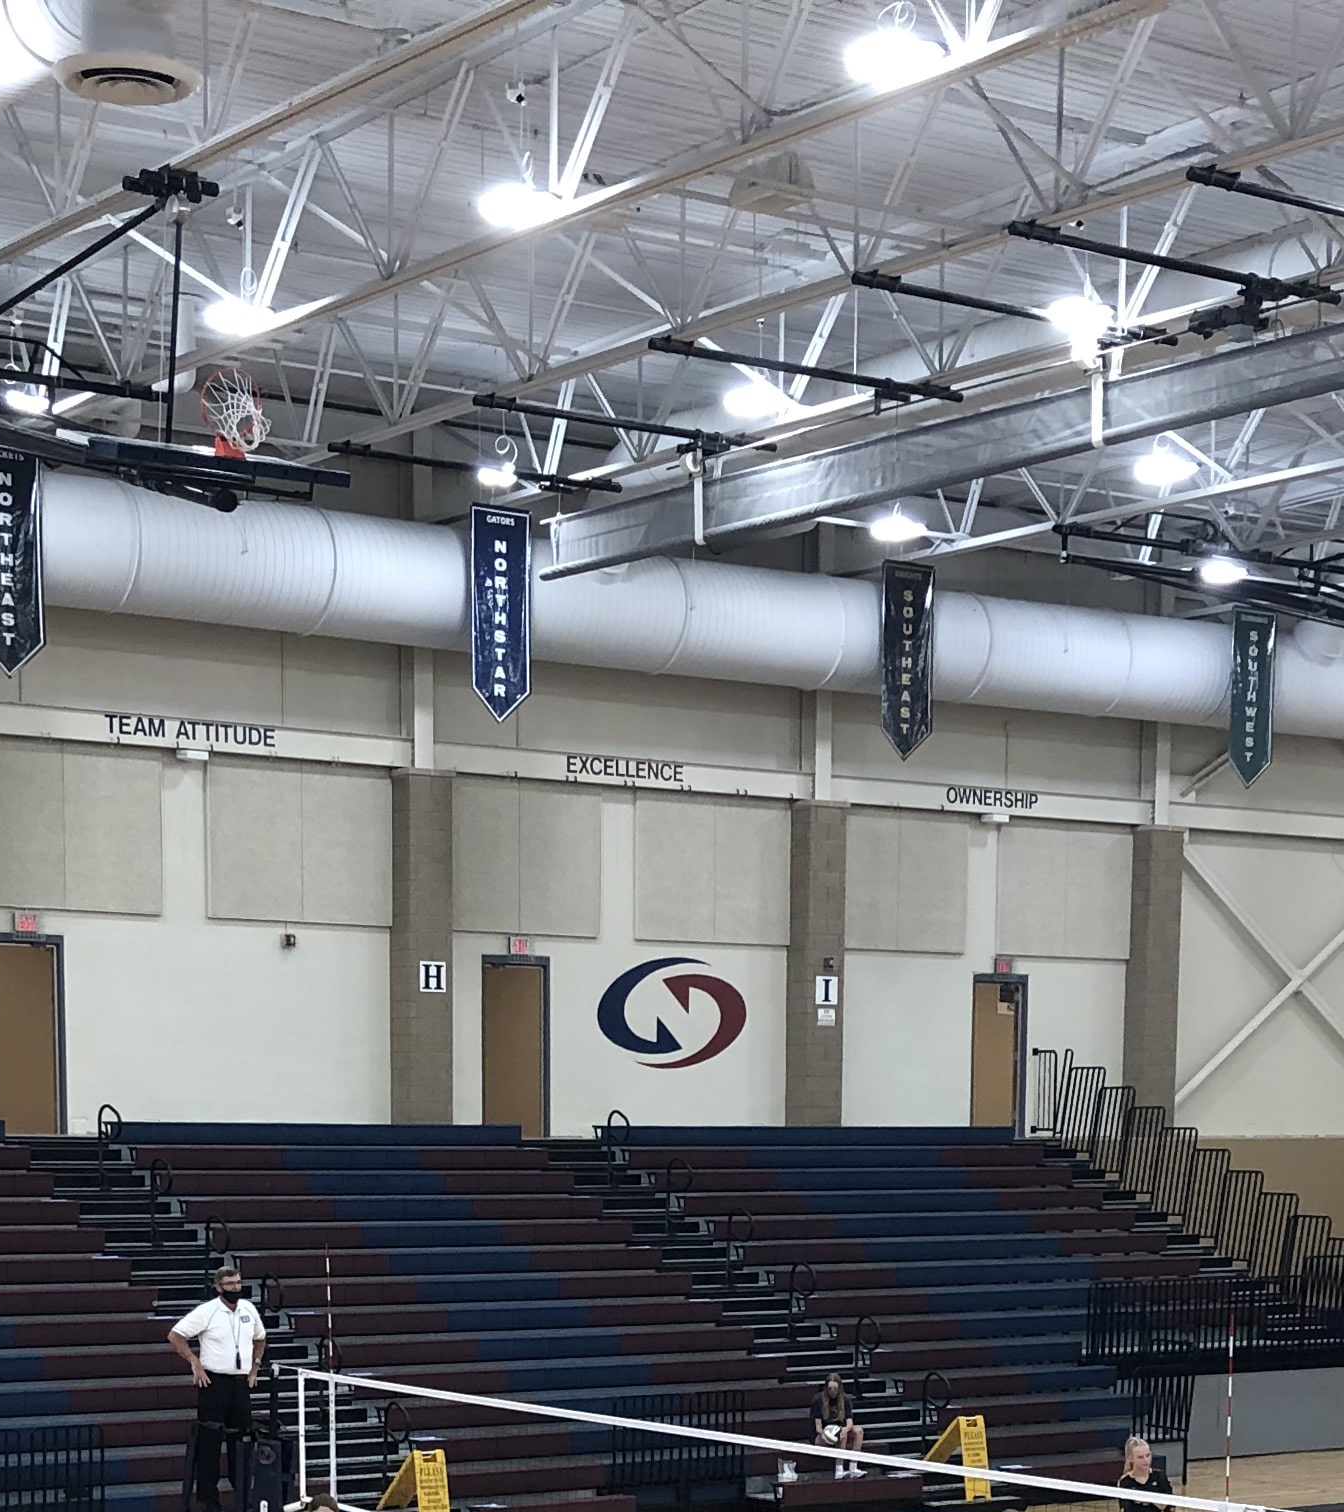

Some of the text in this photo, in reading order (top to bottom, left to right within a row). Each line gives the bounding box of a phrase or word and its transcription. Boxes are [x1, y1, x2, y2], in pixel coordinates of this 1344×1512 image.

[486, 515, 515, 526] GATORS
[900, 590, 914, 735] SOUTHEAST
[1244, 631, 1258, 763] SOUTHWEST
[105, 714, 276, 747] TEAM ATTITUDE
[566, 755, 684, 782] EXCELLENCE
[946, 786, 1039, 809] OWNERSHIP
[422, 964, 445, 989] H
